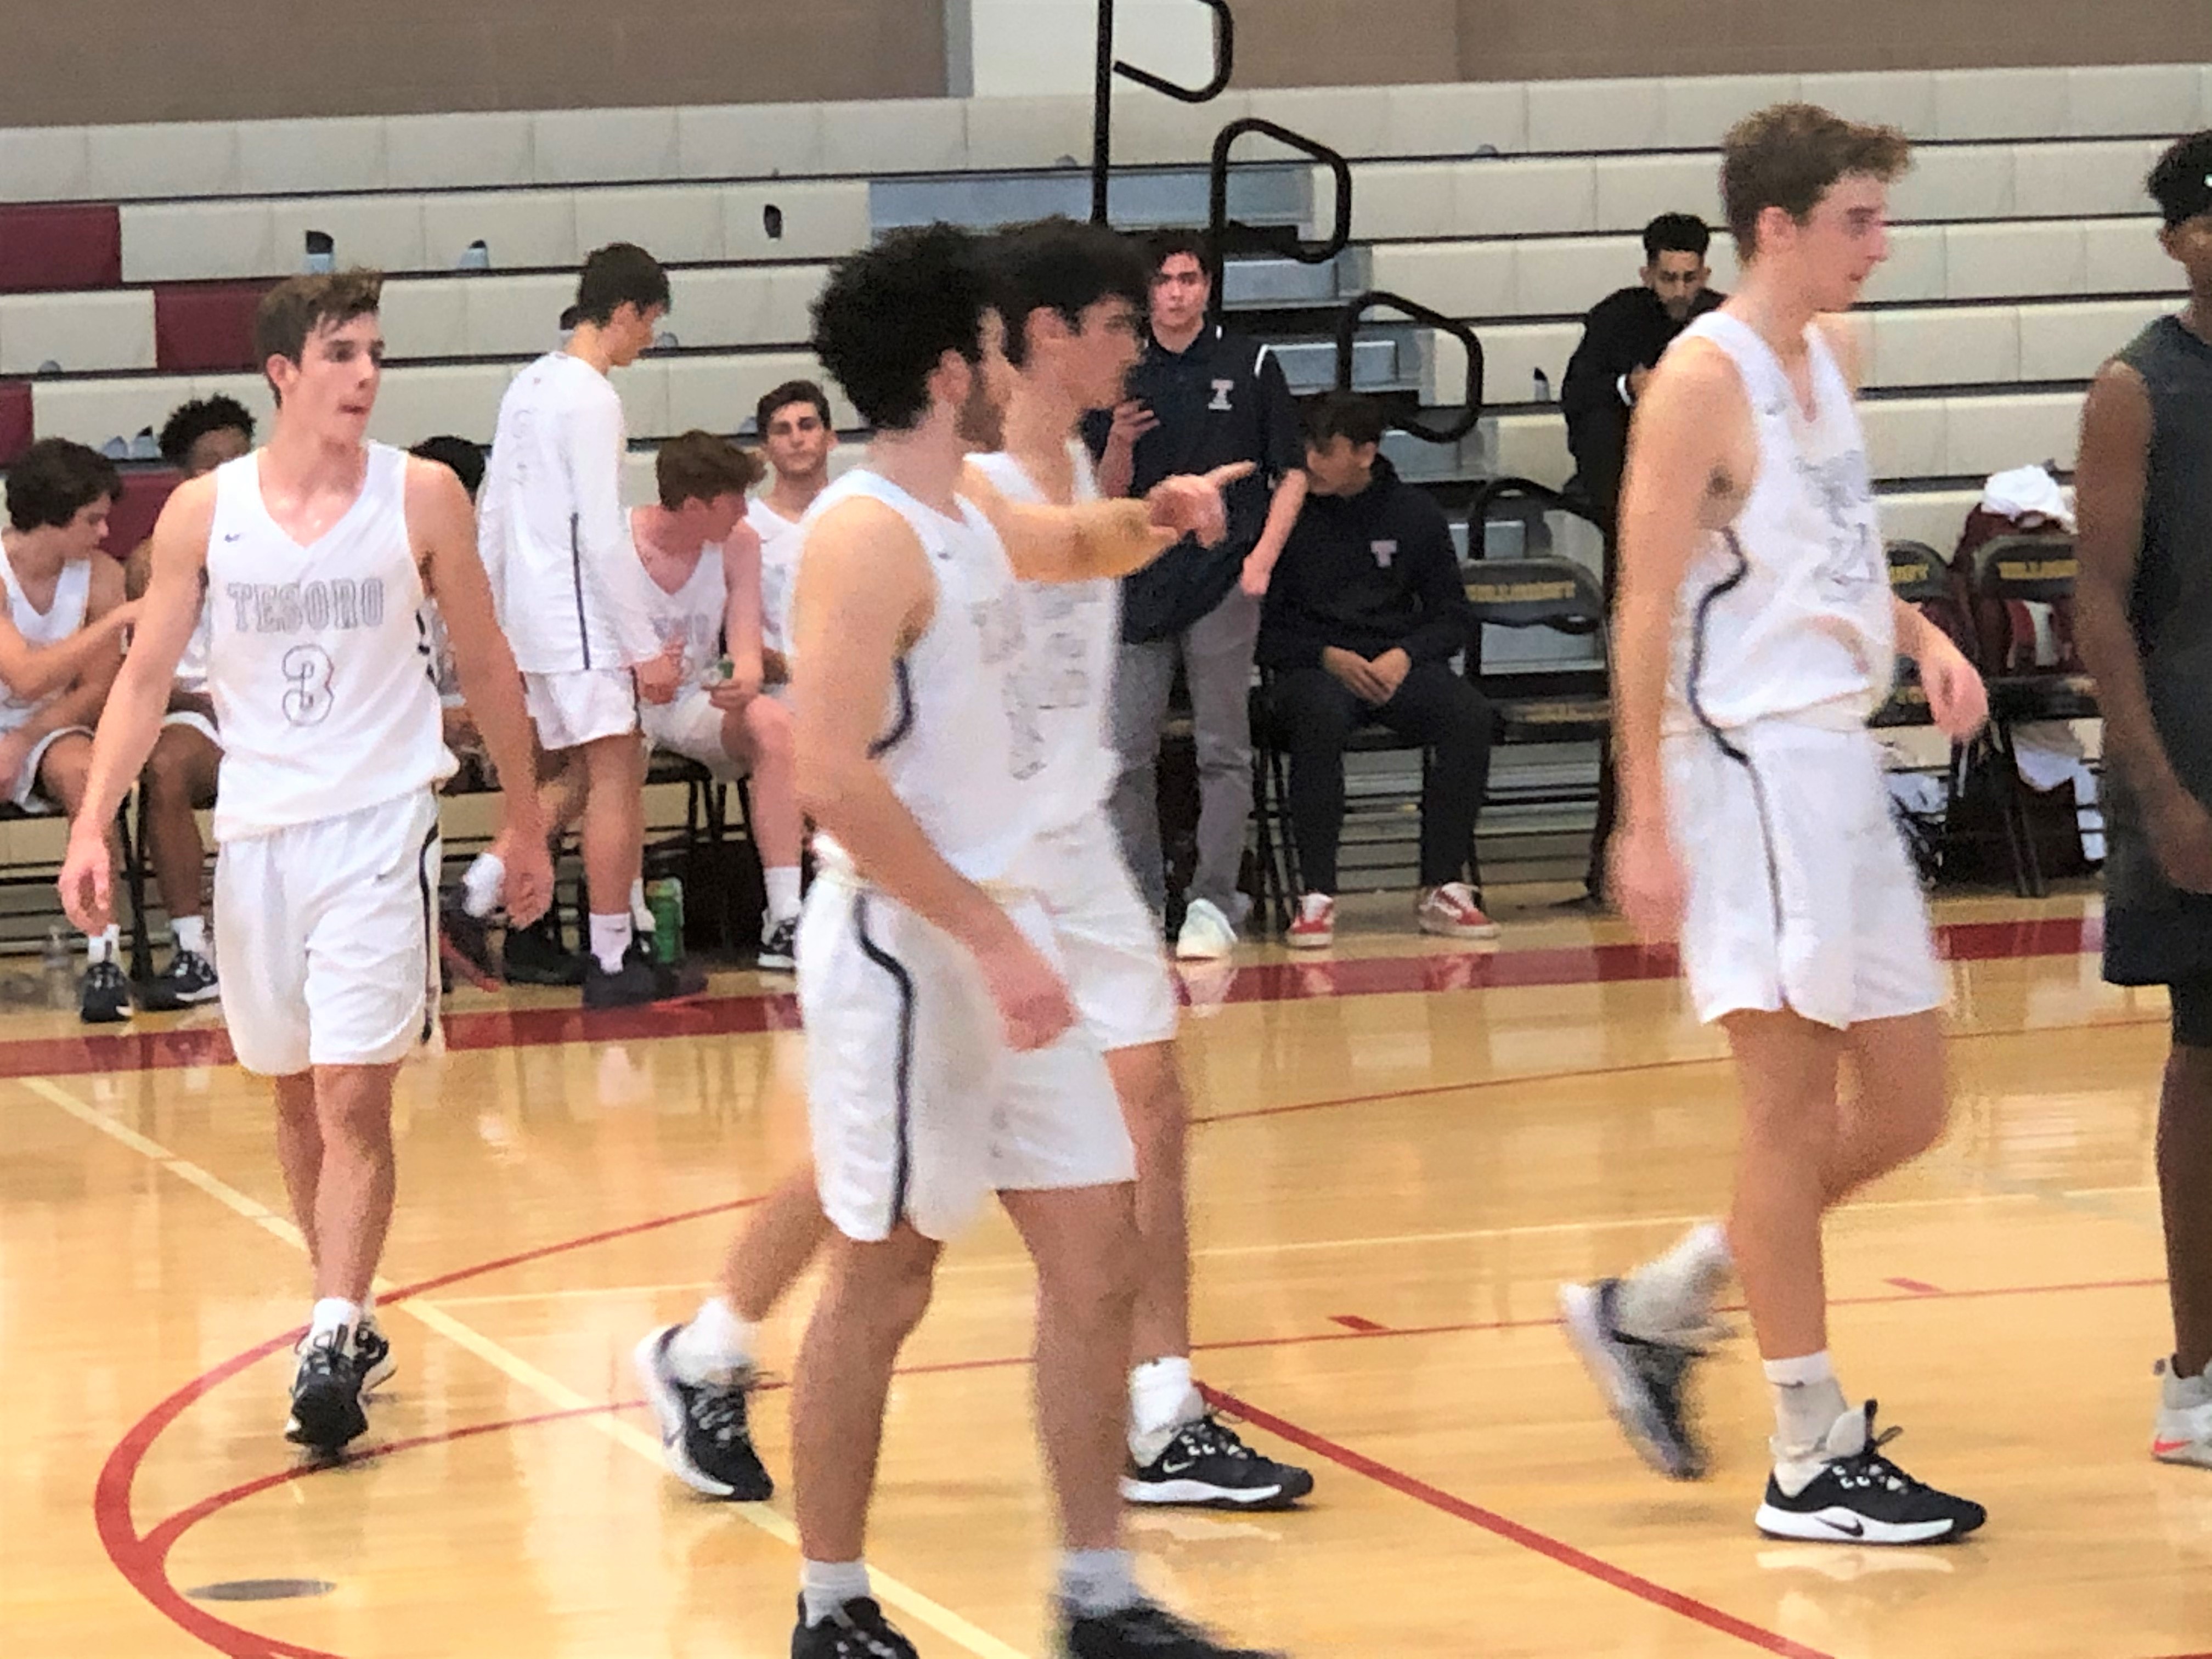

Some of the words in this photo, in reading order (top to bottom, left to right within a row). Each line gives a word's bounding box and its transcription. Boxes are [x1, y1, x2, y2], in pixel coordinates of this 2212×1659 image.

[1371, 540, 1397, 567] T
[227, 578, 383, 633] TESORO
[282, 644, 335, 727] 3
